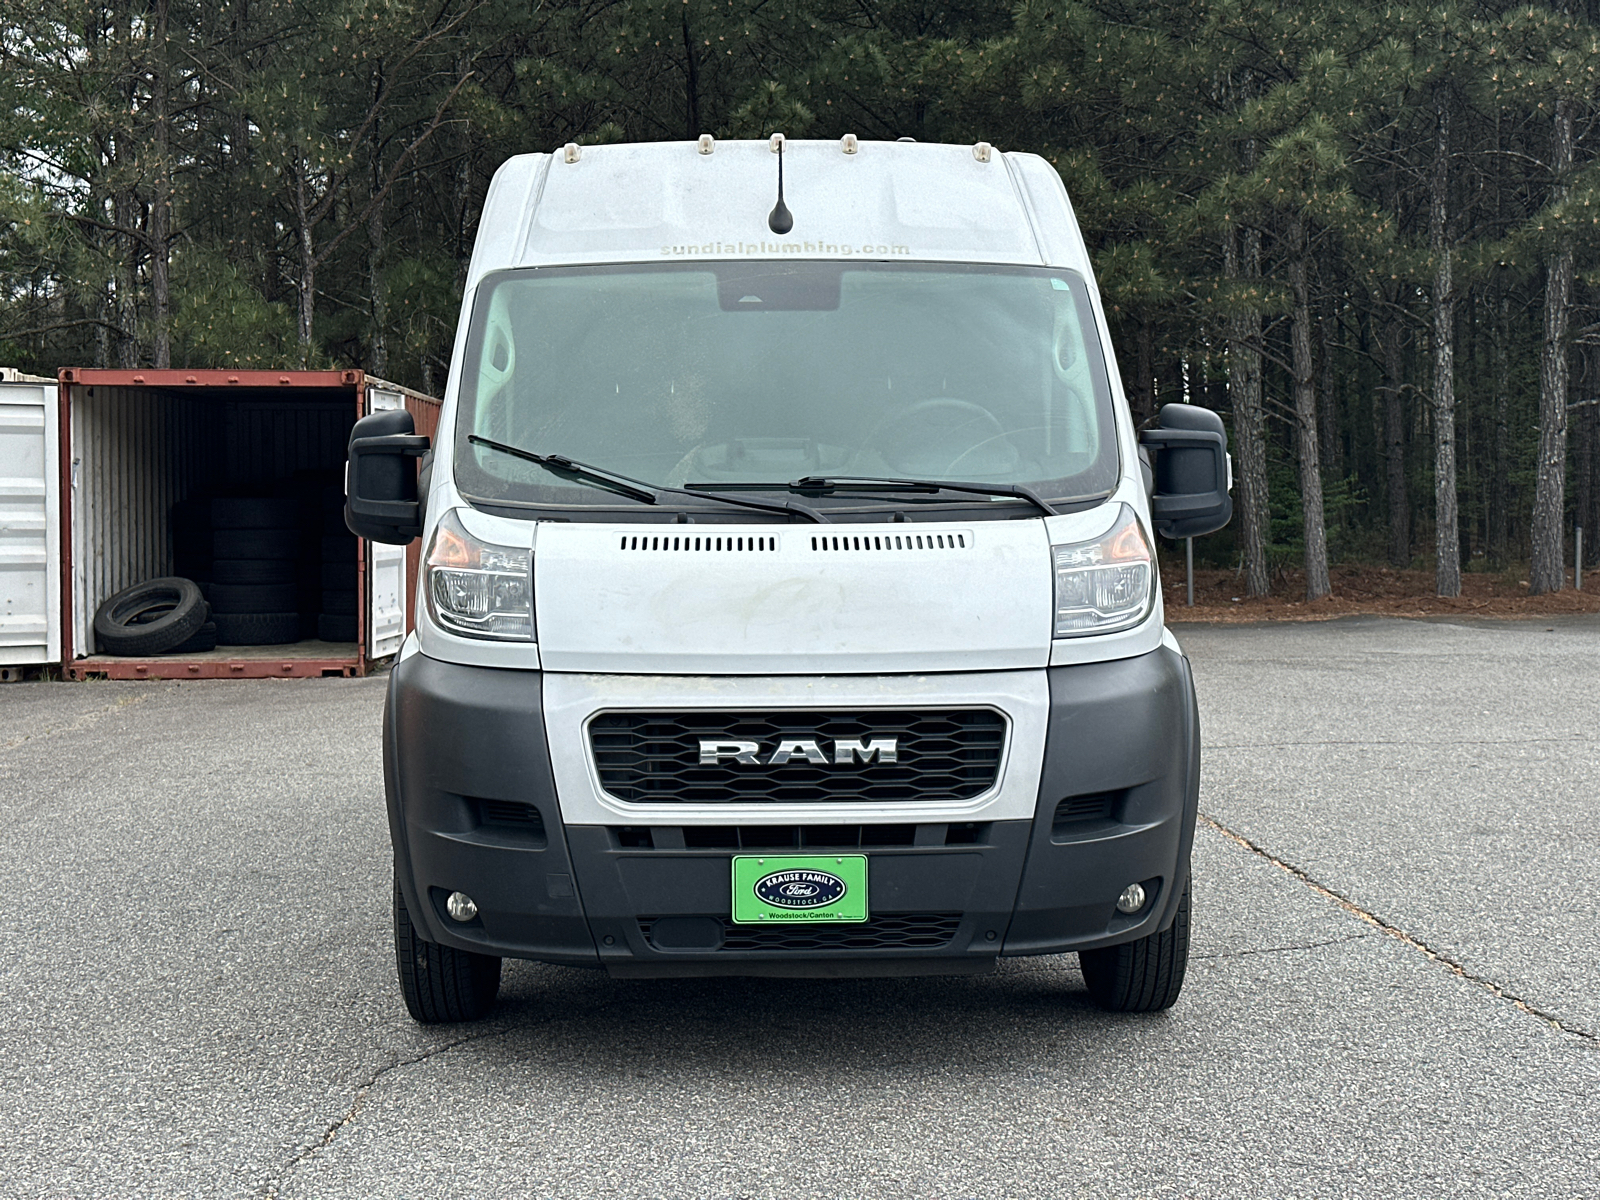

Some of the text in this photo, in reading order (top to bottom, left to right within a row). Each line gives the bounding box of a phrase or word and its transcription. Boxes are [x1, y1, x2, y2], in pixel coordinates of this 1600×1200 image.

[660, 241, 911, 256] sundialplumbing.com
[699, 739, 898, 765] RAM
[765, 873, 835, 887] KRAUSE FAMILY
[786, 884, 813, 895] Ford
[822, 894, 833, 902] GA
